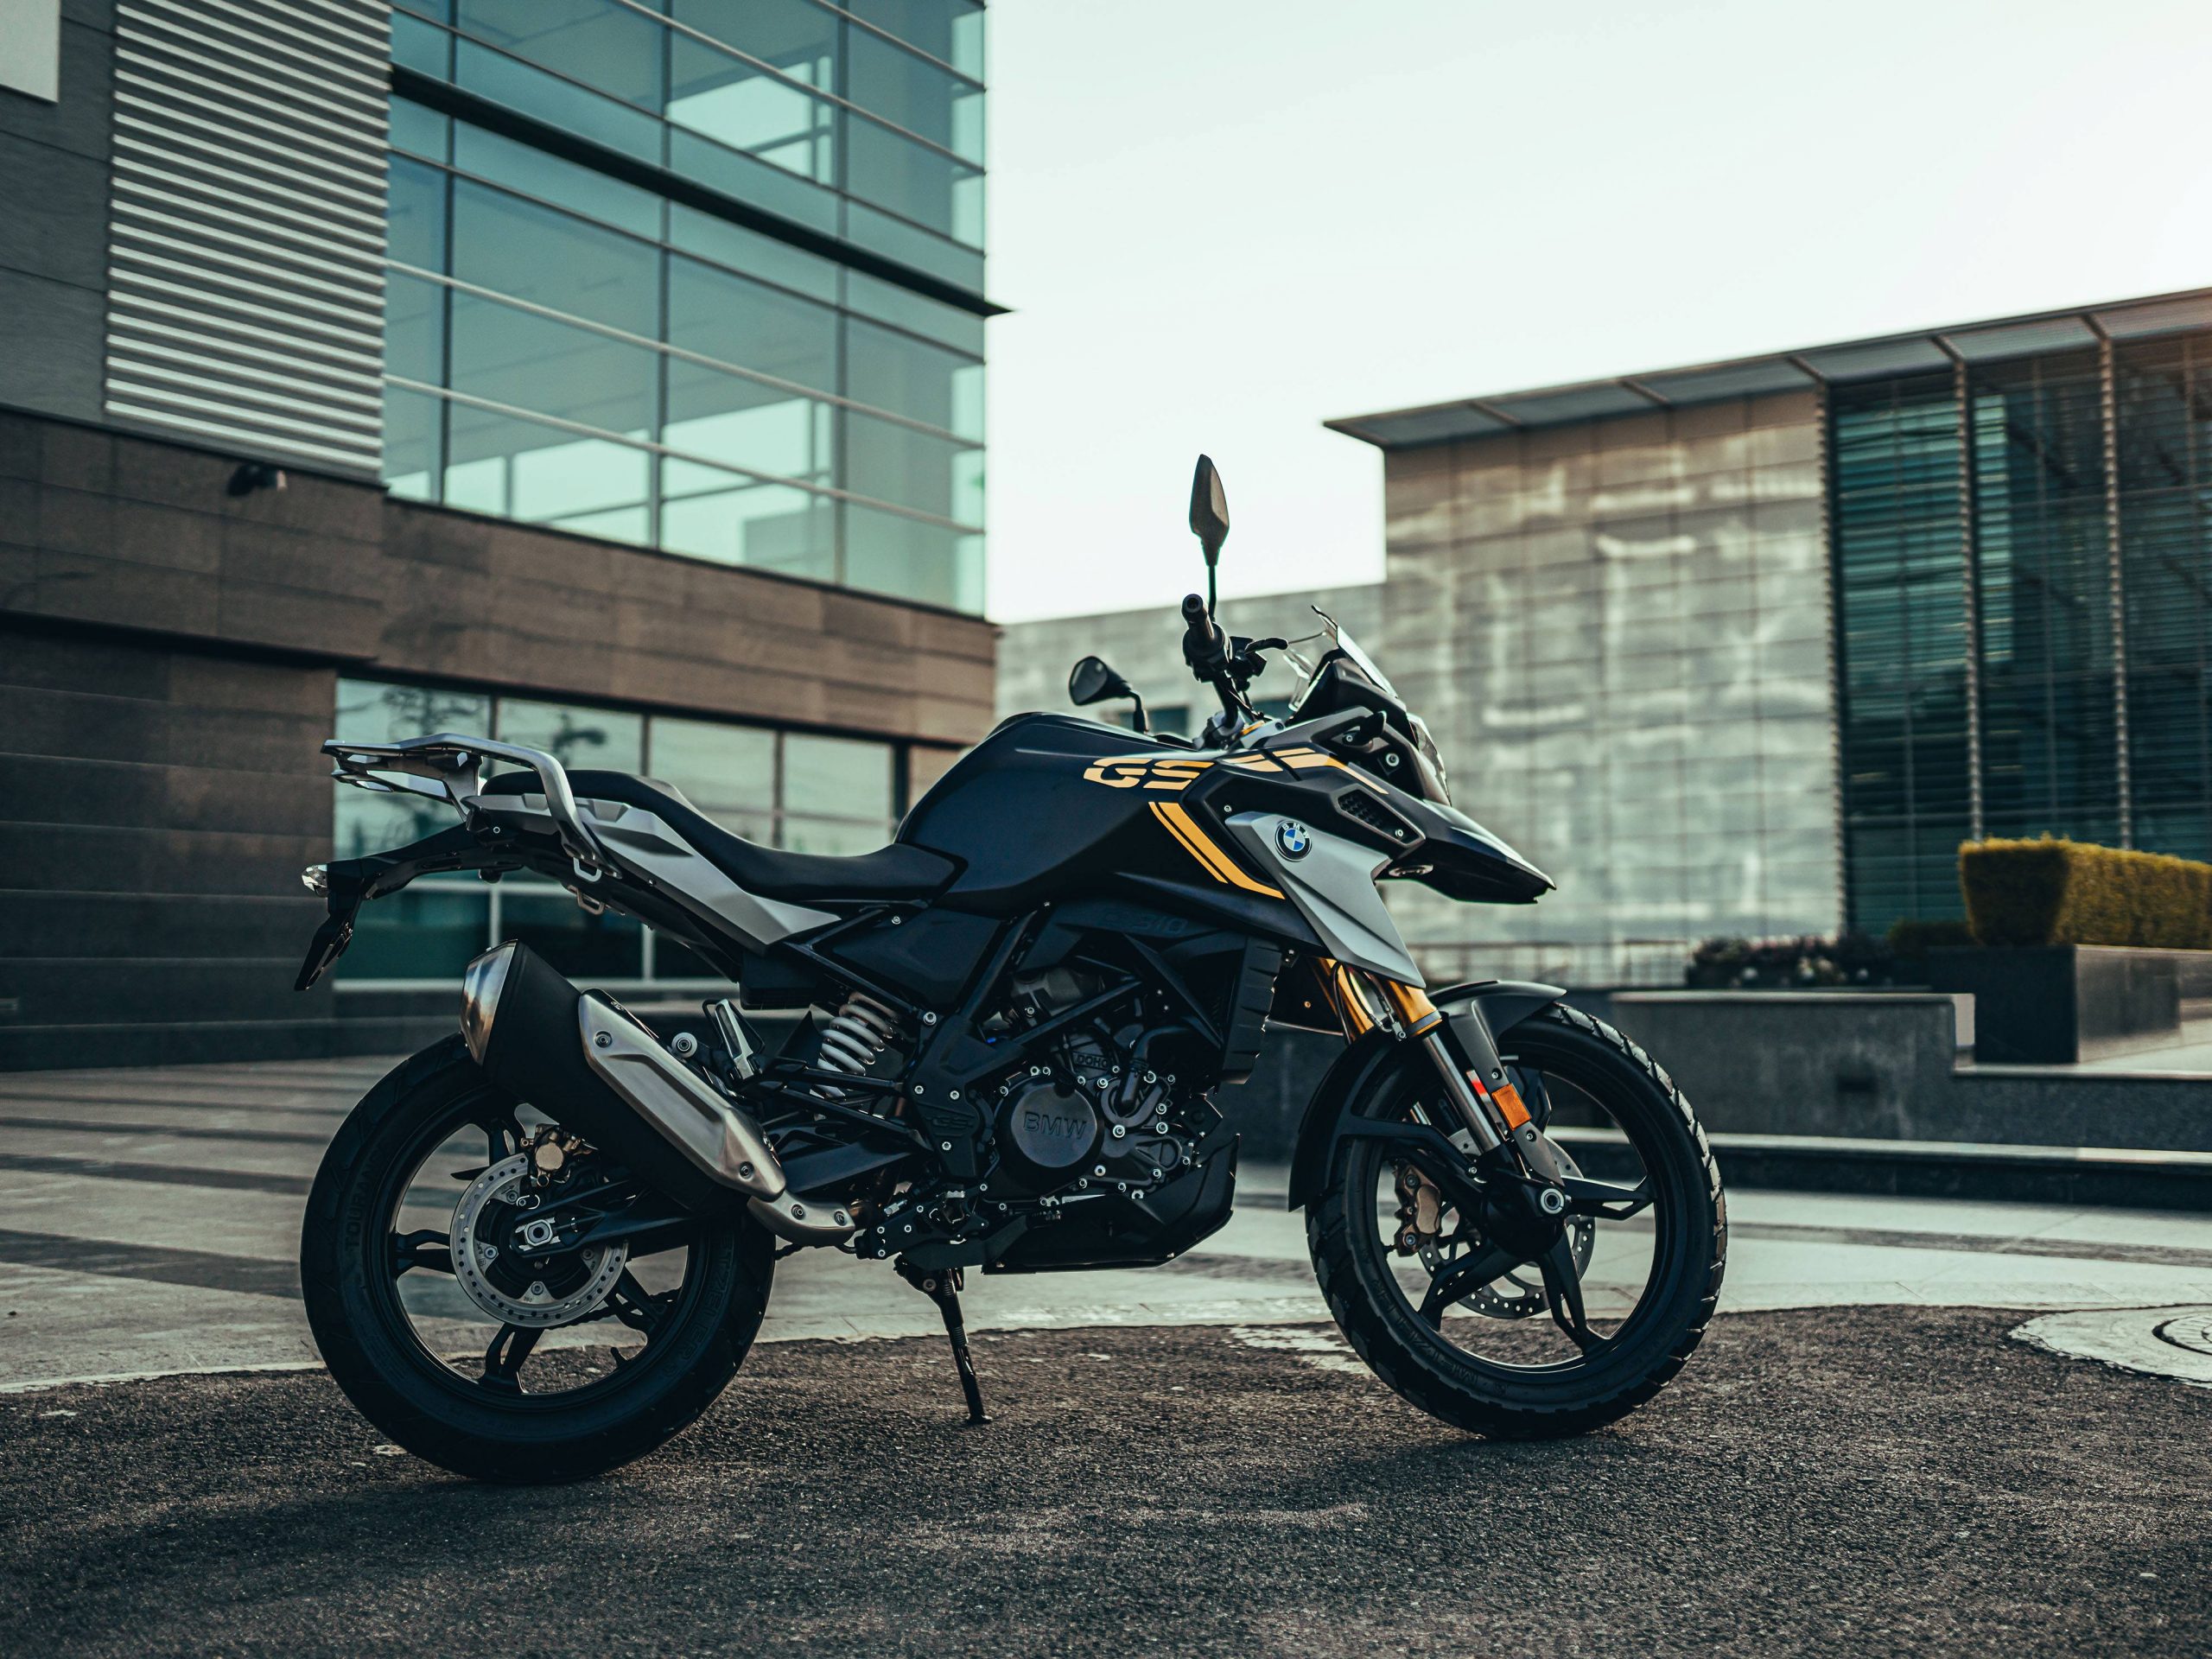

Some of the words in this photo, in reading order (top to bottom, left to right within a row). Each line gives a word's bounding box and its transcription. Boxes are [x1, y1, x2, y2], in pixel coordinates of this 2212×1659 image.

[1083, 758, 1215, 791] GS
[1282, 823, 1310, 838] BMW
[1132, 913, 1189, 935] 310
[932, 1116, 969, 1129] GS
[1023, 1111, 1088, 1140] BMW
